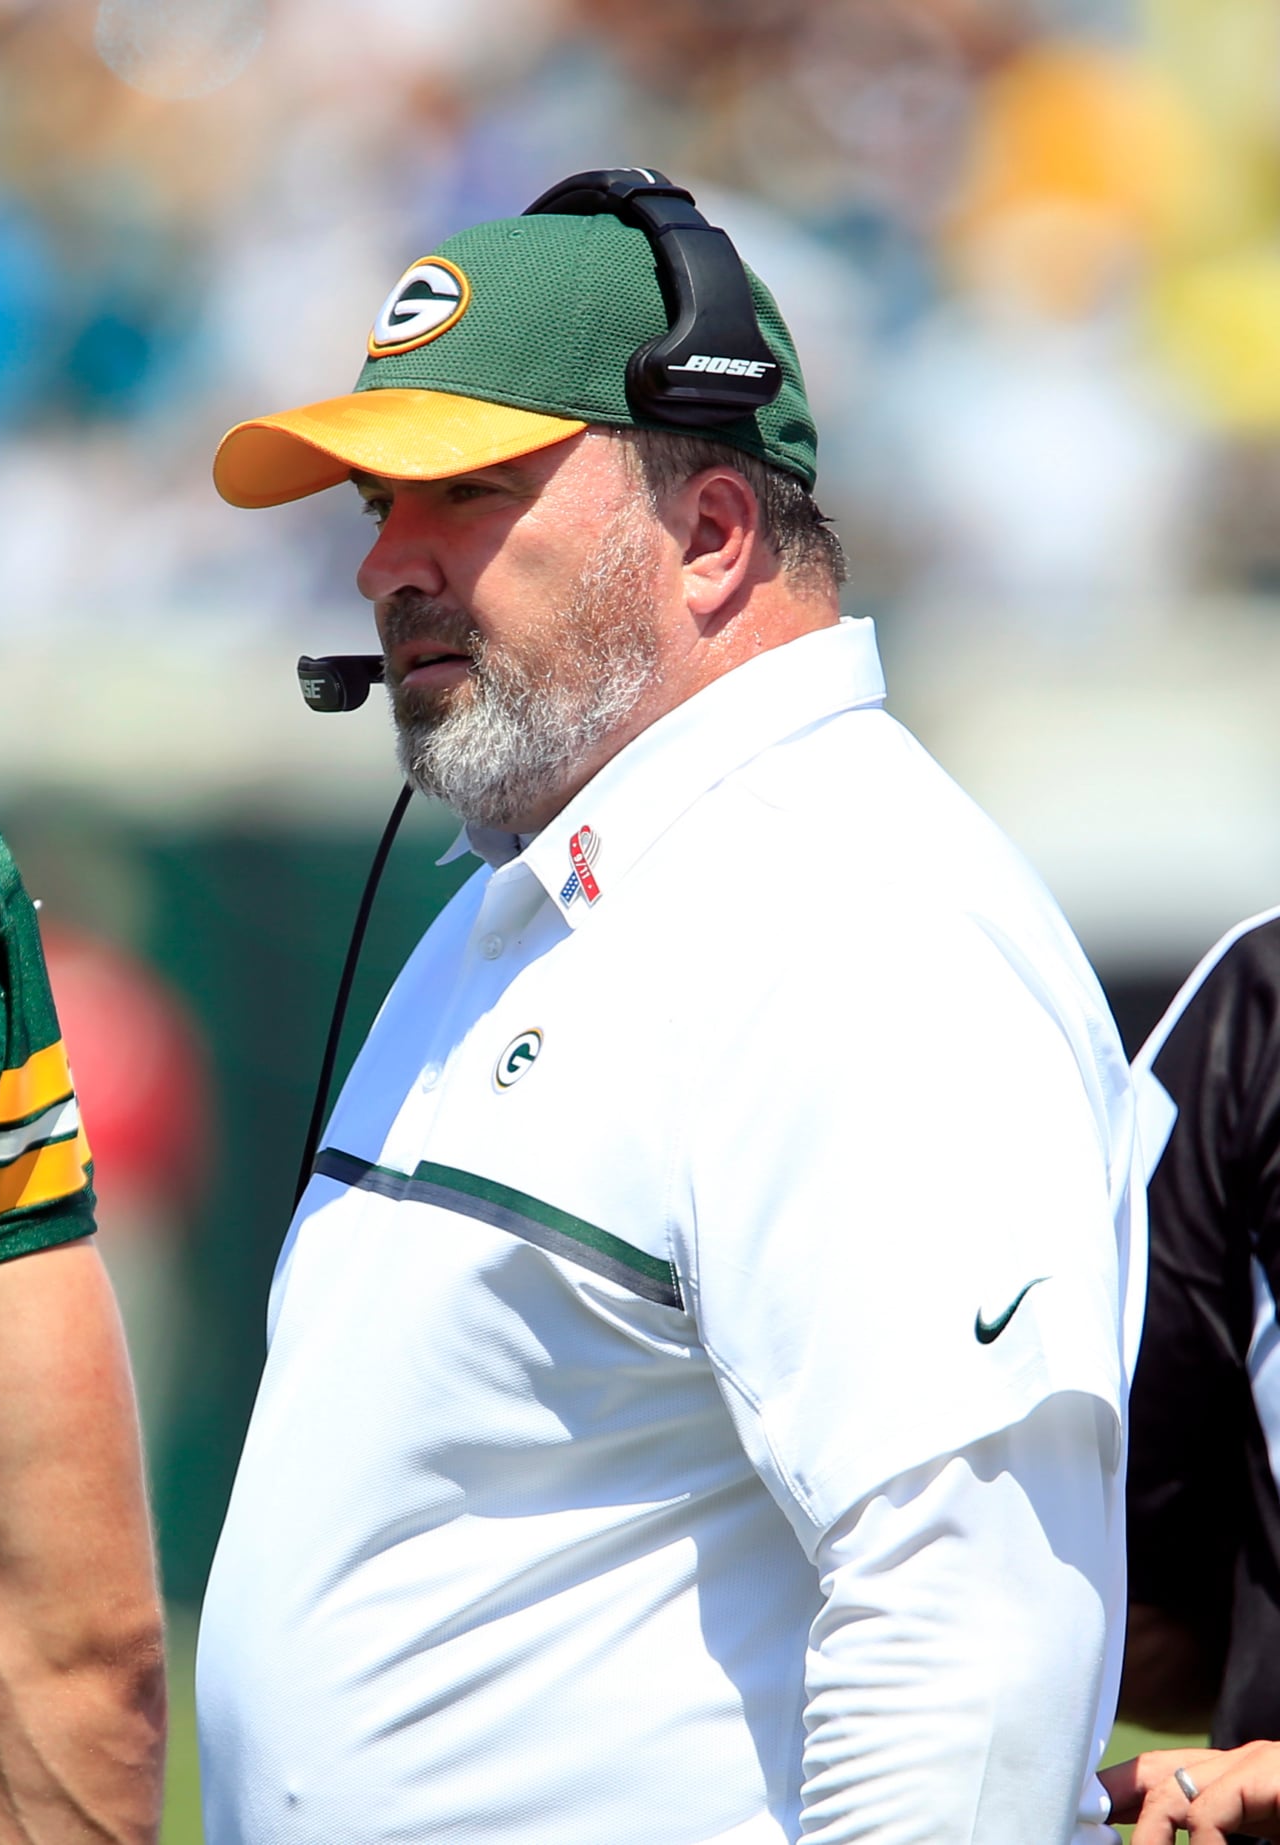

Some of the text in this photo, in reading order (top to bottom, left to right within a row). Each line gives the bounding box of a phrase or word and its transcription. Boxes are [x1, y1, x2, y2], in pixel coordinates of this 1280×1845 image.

[374, 263, 460, 345] G
[668, 355, 776, 378] BOSE
[300, 679, 325, 698] SE
[573, 853, 590, 880] 9/11
[497, 1030, 542, 1086] G
